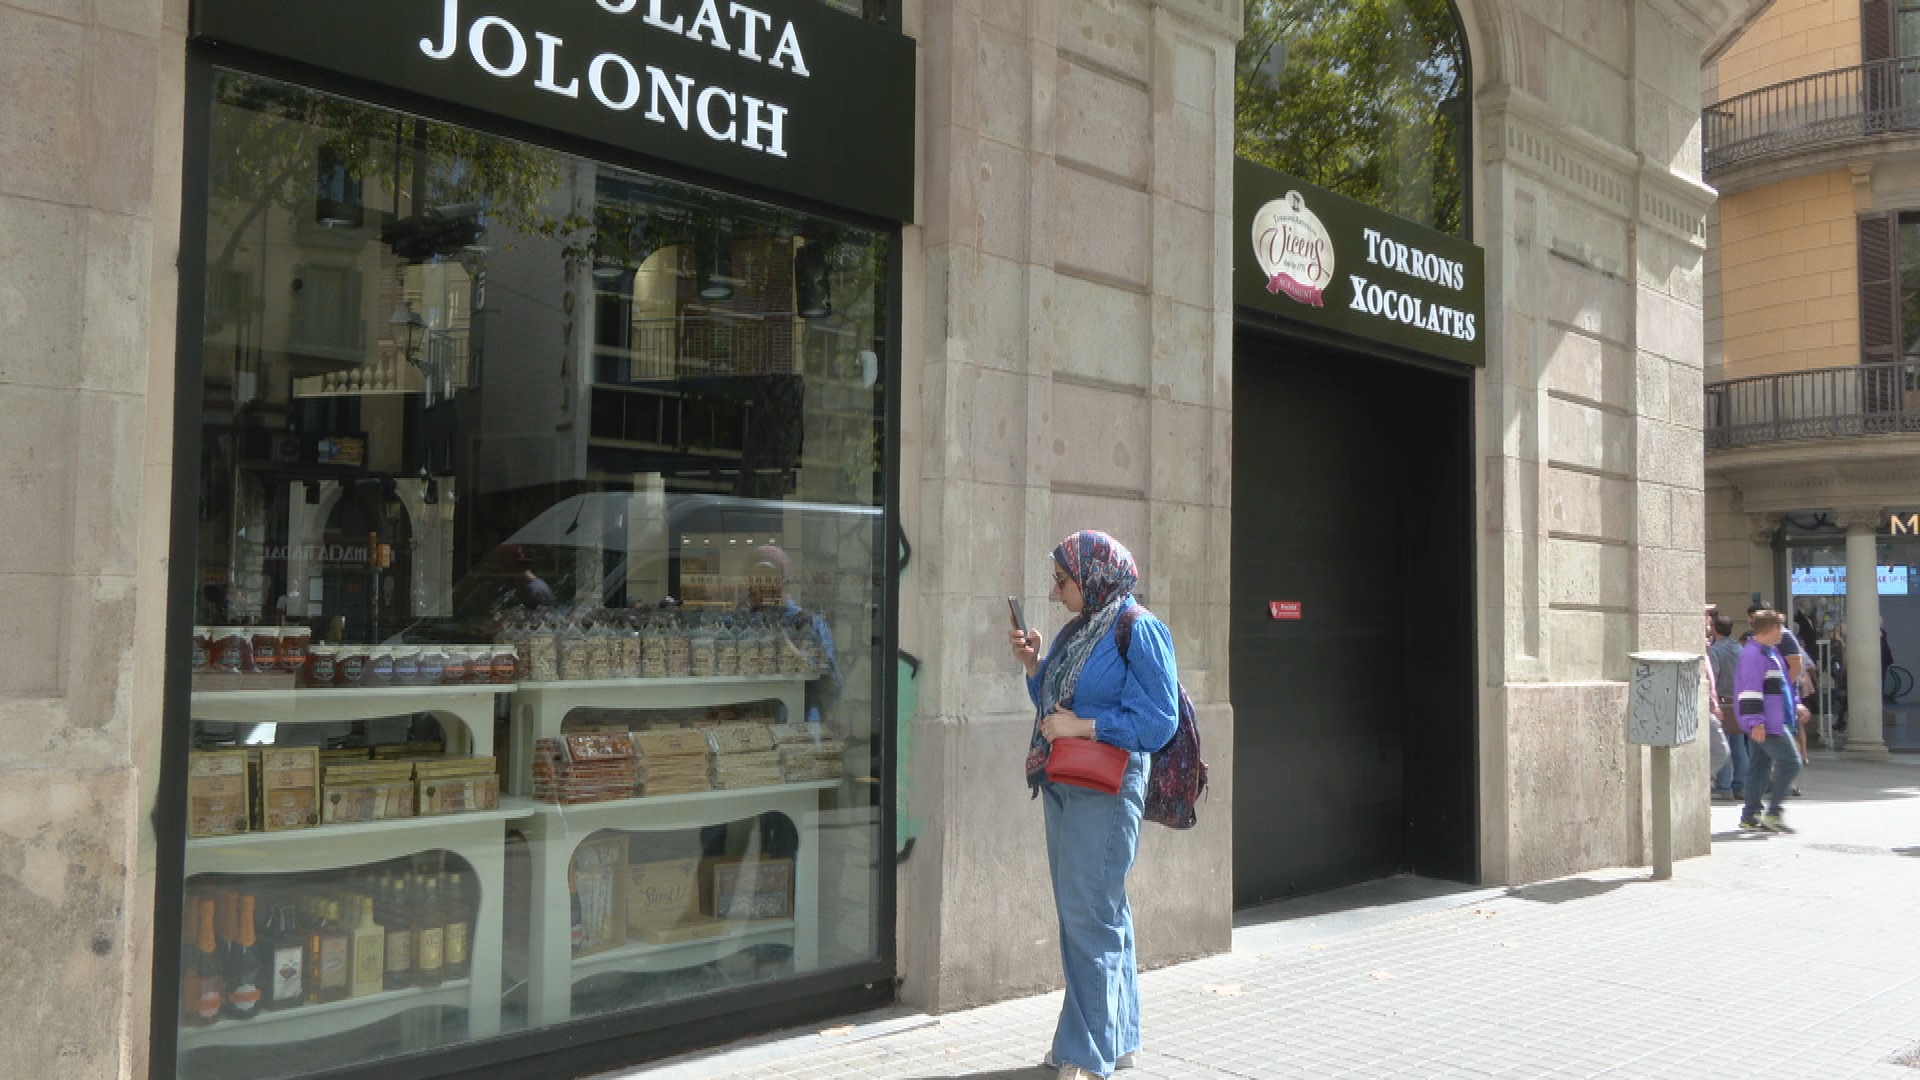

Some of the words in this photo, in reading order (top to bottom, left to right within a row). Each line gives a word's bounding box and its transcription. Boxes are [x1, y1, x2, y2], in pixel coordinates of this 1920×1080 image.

[596, 0, 810, 78] LATA
[419, 0, 788, 158] JOLONCH
[1364, 228, 1464, 291] TORRONS
[1349, 274, 1476, 341] XOCOLATES
